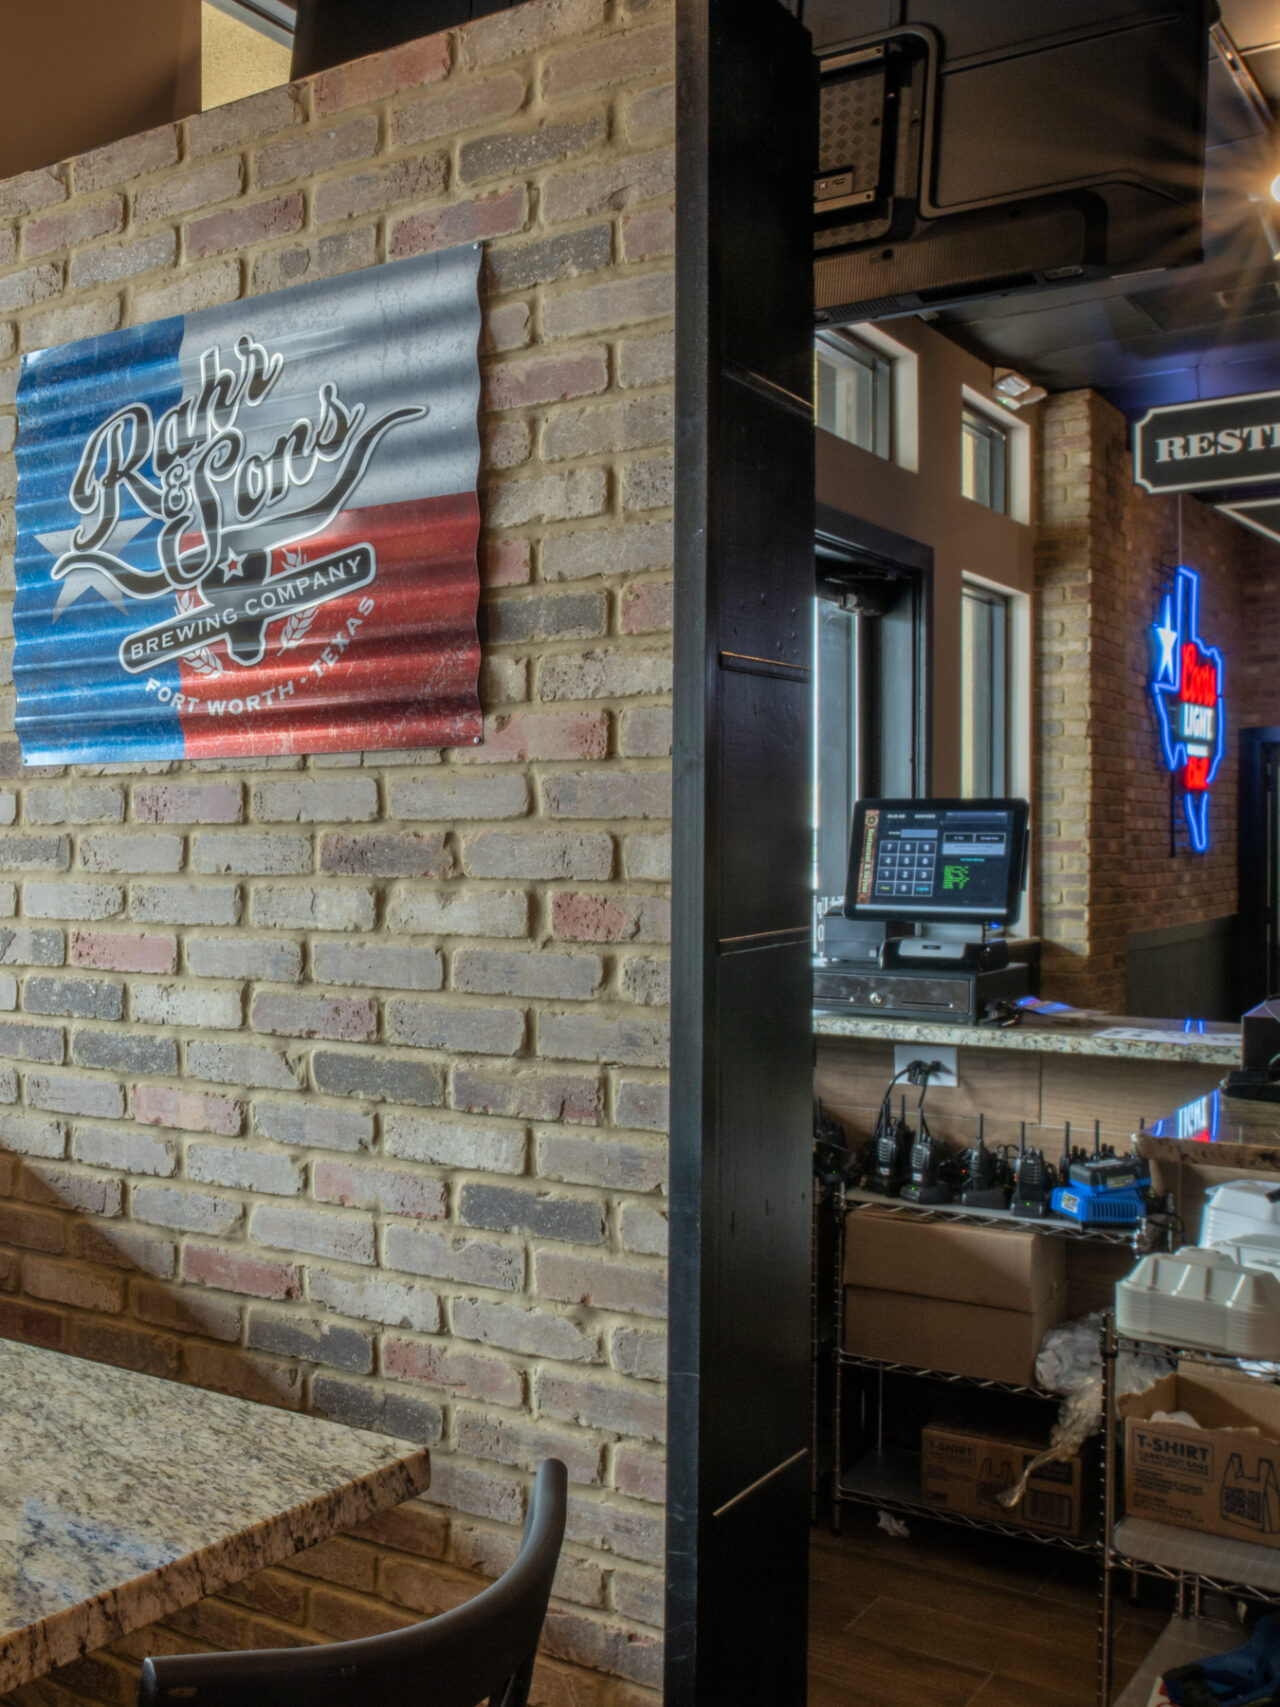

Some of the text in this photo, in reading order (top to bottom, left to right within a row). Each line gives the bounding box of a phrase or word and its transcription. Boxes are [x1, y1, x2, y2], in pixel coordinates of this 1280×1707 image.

[70, 335, 283, 551] Rahr
[158, 381, 365, 589] & Sons
[131, 555, 361, 660] BREWING COMPANY
[145, 596, 375, 716] FORT WORTH TEXAS
[1184, 703, 1214, 741] LIGHT
[1136, 1434, 1209, 1462] T-SHIRT
